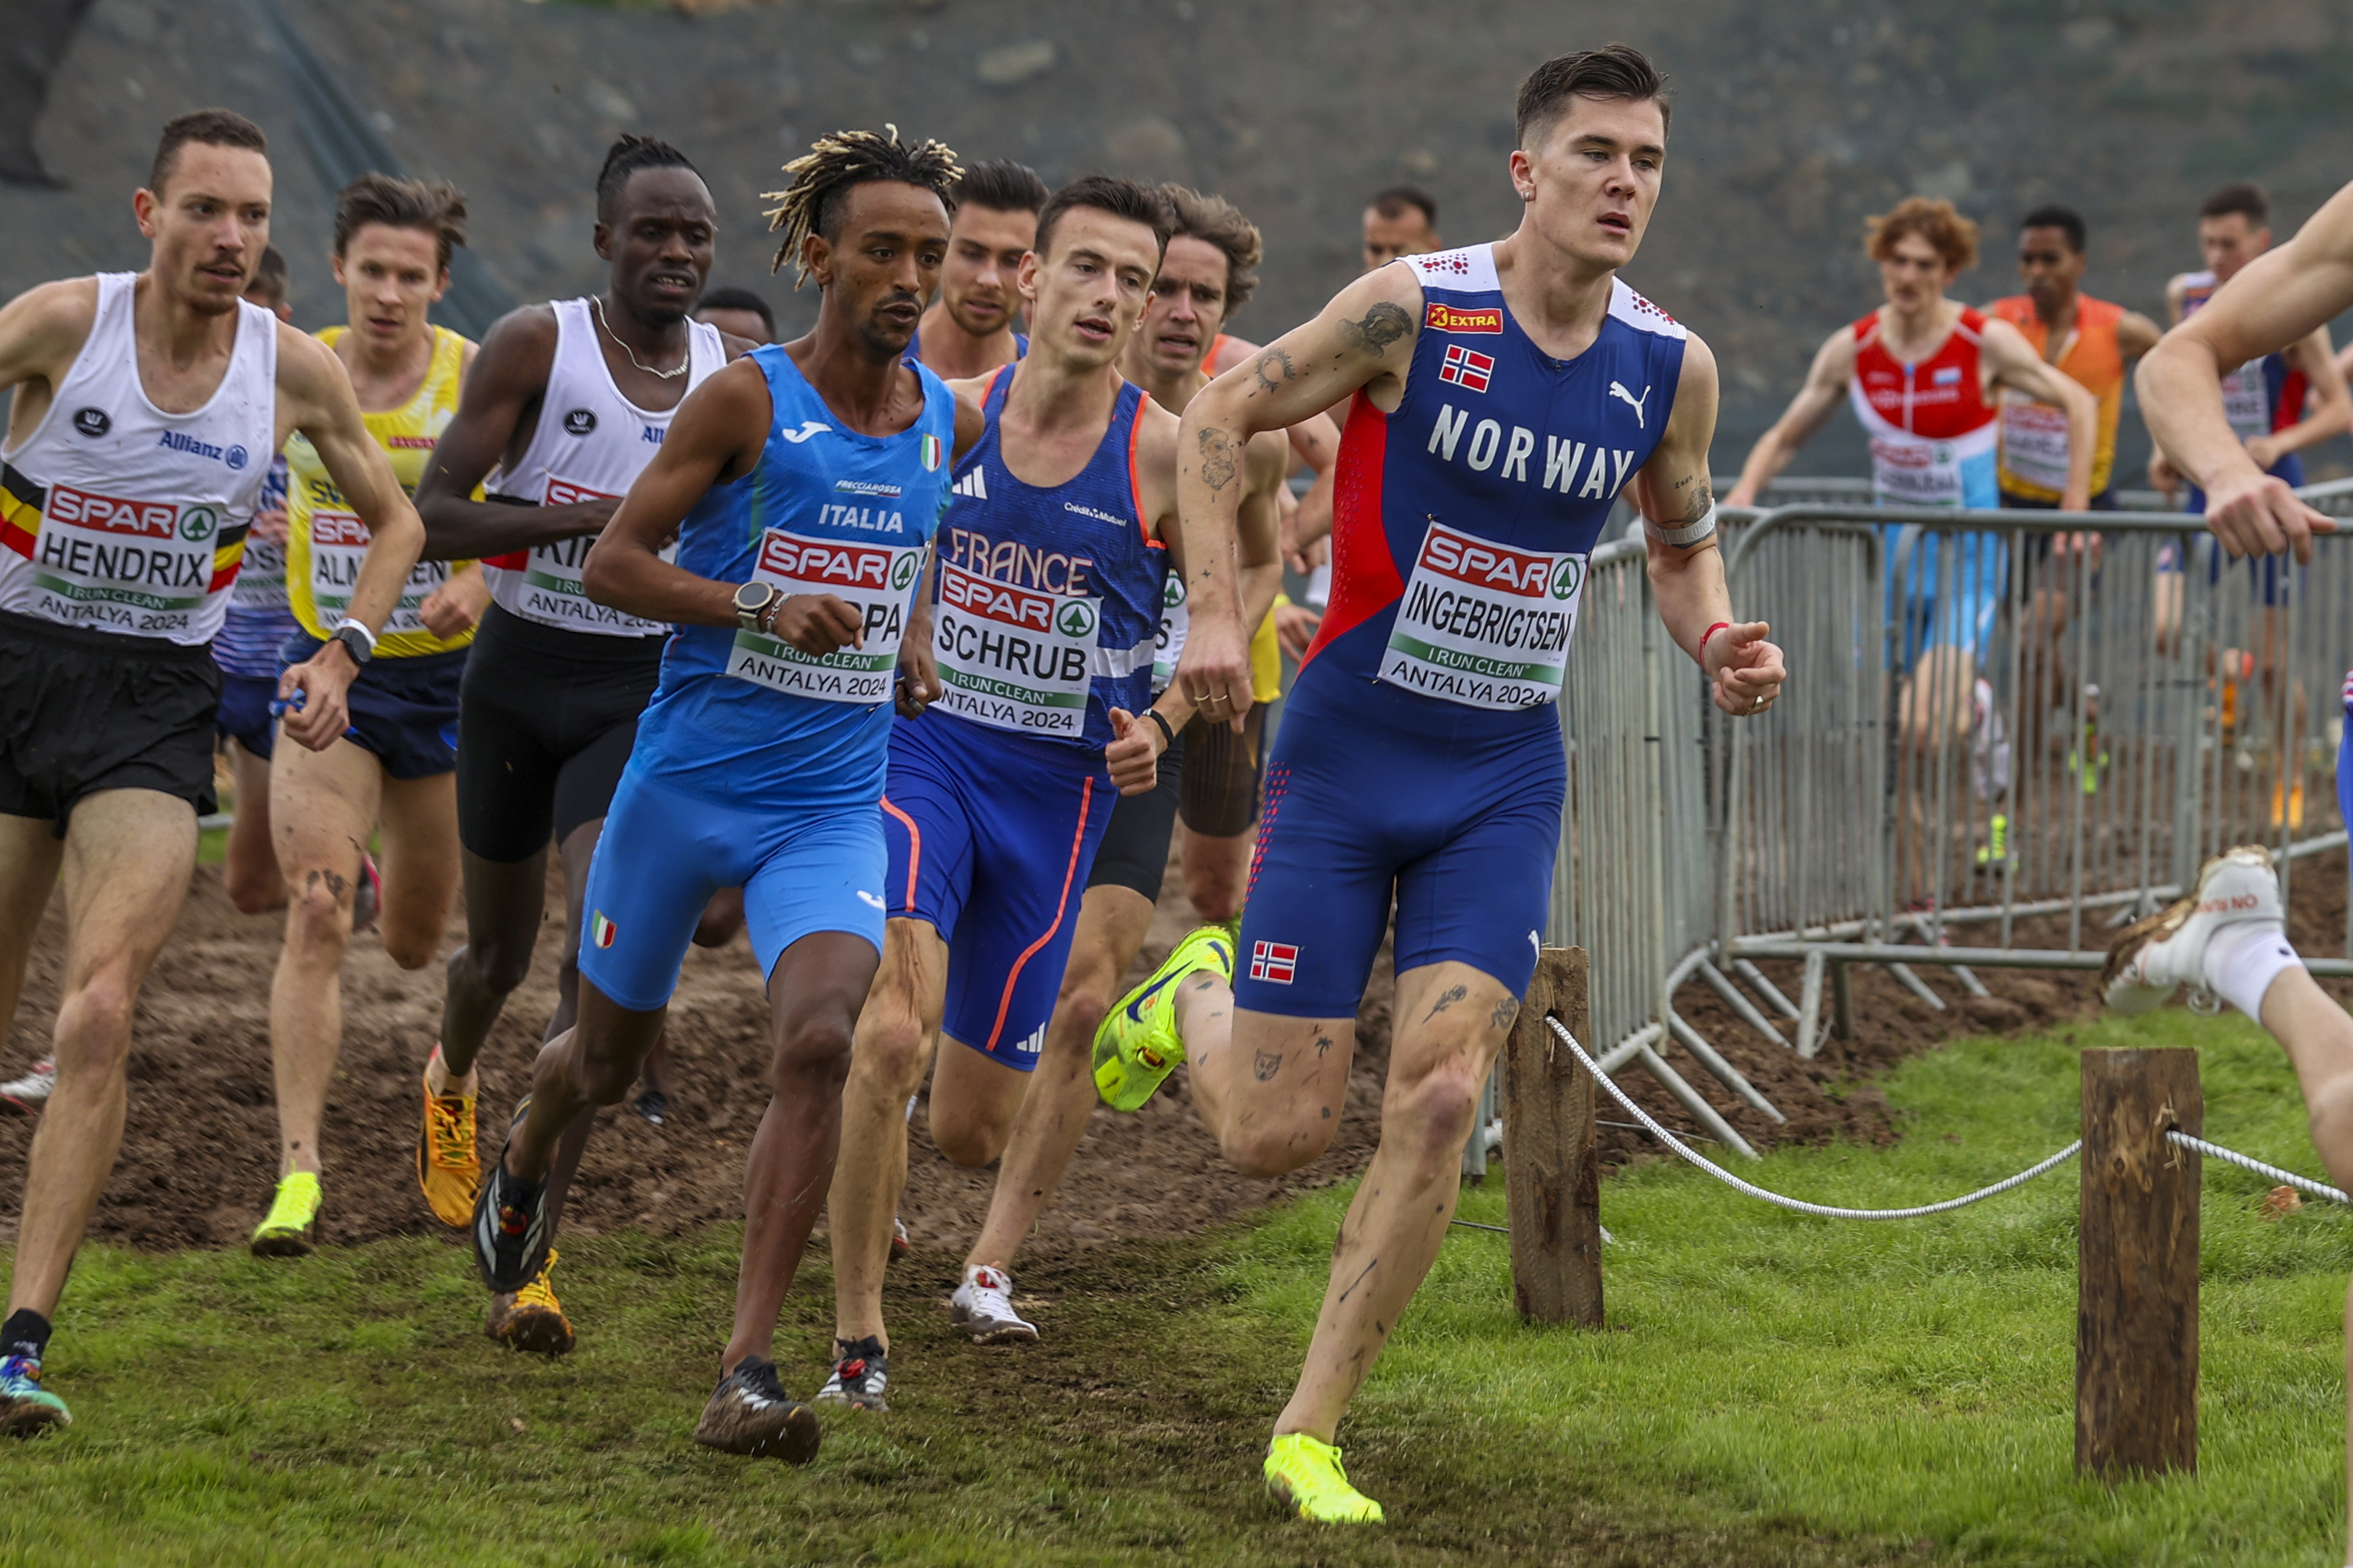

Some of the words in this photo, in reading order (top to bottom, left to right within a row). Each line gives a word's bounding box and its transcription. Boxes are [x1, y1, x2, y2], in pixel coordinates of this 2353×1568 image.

[1450, 316, 1497, 326] EXTRA
[158, 430, 223, 460] Allianz
[1427, 403, 1635, 499] NORWAY
[835, 480, 902, 494] FRECCIAROSSA
[51, 490, 175, 534] SPAR
[818, 503, 903, 533] ITALIA
[1064, 502, 1090, 516] Crédit
[1098, 511, 1127, 527] Mutuel
[42, 532, 208, 588] HENDRIX
[765, 539, 888, 584] SPAR
[951, 527, 1093, 596] FRANCE
[1425, 535, 1549, 592] SPAR
[40, 595, 134, 627] ANTALYA
[139, 614, 190, 630] 2024
[76, 587, 110, 601] RUN
[527, 593, 620, 624] ANTALYA
[944, 575, 1051, 627] SPAR
[1406, 580, 1572, 651] INGEBRIGTSEN
[774, 644, 780, 656] I
[938, 615, 1087, 682] SCHRUB
[1428, 647, 1435, 660] I
[1436, 650, 1474, 669] RUN
[739, 656, 842, 694] ANTALYA
[847, 677, 887, 696] 2024
[952, 671, 957, 683] I
[958, 673, 992, 692] RUN
[1391, 660, 1494, 702] ANTALYA
[1496, 685, 1547, 705] 2024
[939, 688, 1016, 723] NTALYA
[1021, 711, 1075, 731] 2024
